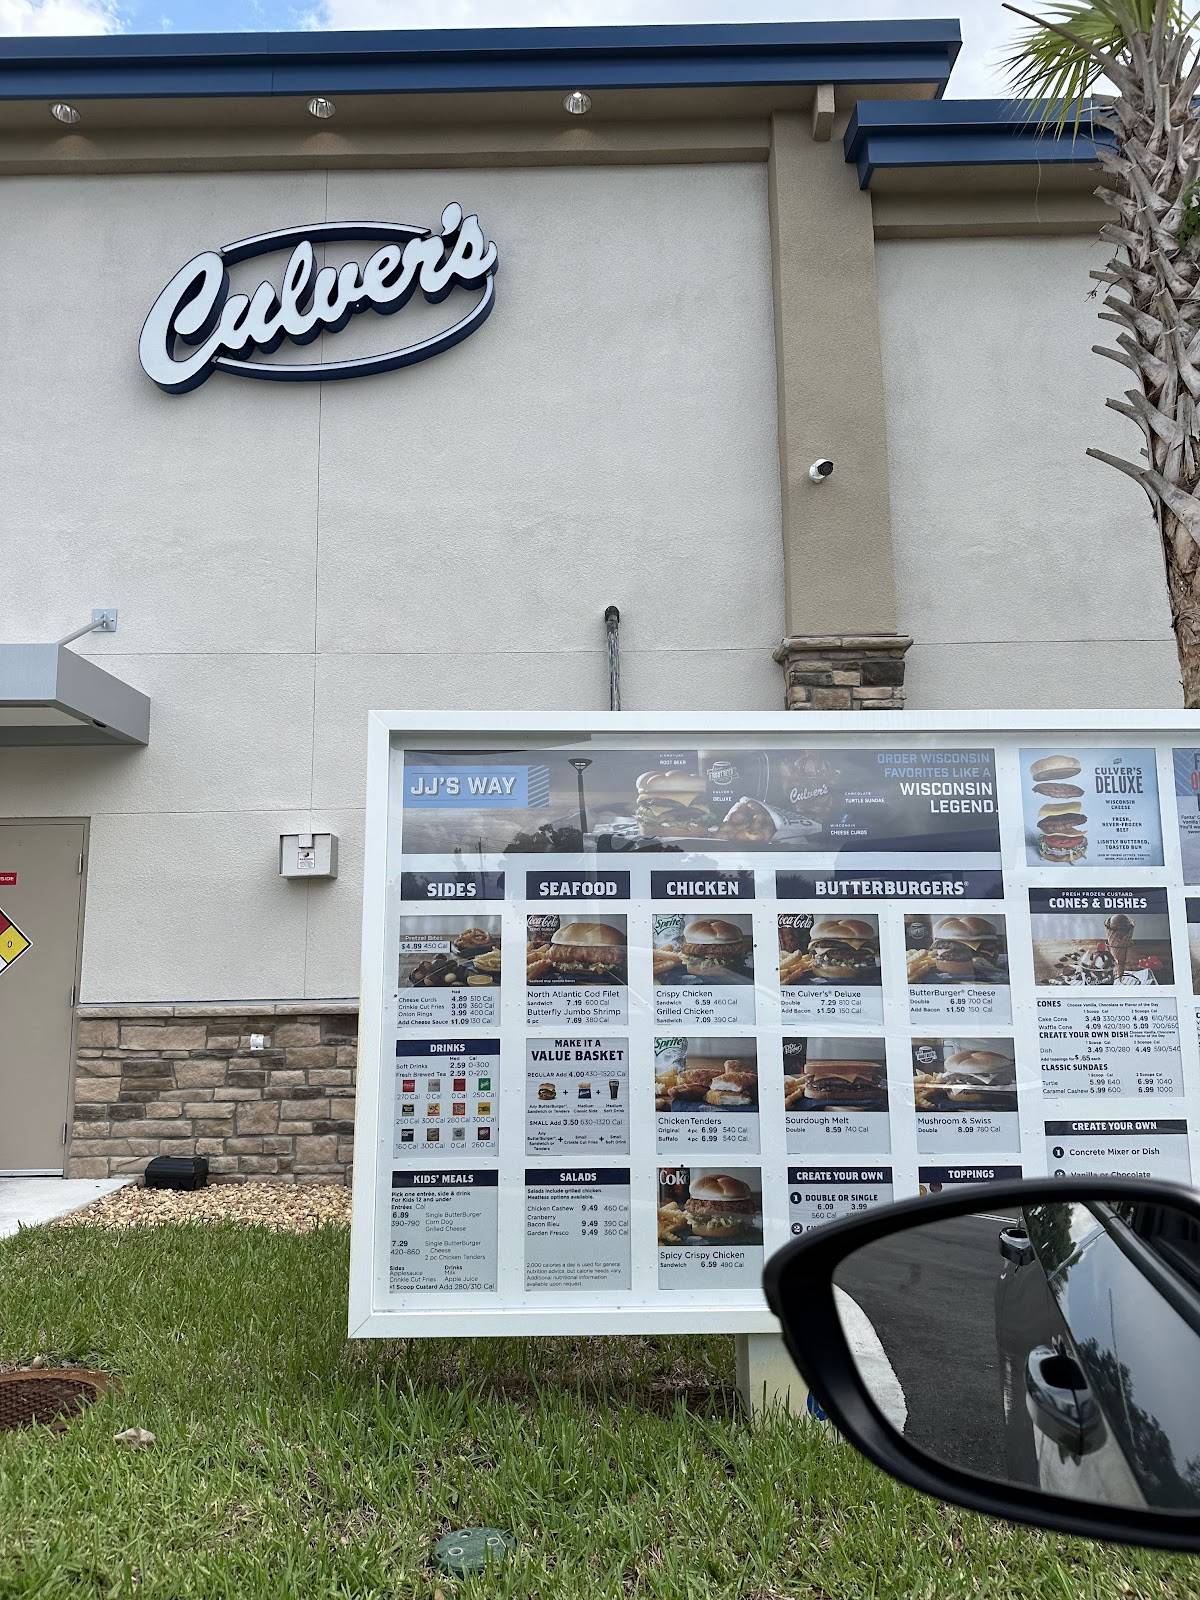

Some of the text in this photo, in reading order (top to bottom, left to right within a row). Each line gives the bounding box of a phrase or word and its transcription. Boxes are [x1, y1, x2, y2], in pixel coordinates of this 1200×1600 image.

[138, 202, 498, 394] Culver's
[877, 753, 990, 764] ORDER WISCONSIN
[884, 767, 991, 778] FAVORITES LIKE A
[1094, 767, 1142, 775] CULVER'S
[467, 777, 516, 795] WAY
[900, 782, 993, 796] WISCONSIN
[1095, 775, 1144, 794] DELUXE
[427, 882, 477, 897] SIDES
[539, 881, 617, 896] SEAFOOD
[666, 881, 739, 896] CHICKEN
[1049, 898, 1148, 909] CONES & DISHES
[655, 919, 680, 929] Sprite
[656, 990, 680, 998] Crispy
[527, 1008, 561, 1016] Butterfly
[593, 1008, 621, 1016] Shrimp
[1039, 1031, 1067, 1039] CREATE
[554, 1039, 601, 1047] MAKE IT A
[430, 1044, 466, 1053] DRINKS
[531, 1050, 624, 1061] VALUE BASKET
[690, 1117, 722, 1125] Tenders
[785, 1117, 830, 1125] Sourdough
[1072, 1121, 1158, 1131] CREATE YOUR OWN
[413, 1174, 474, 1184] KIDS' MEALS
[560, 1172, 597, 1182] SALADS
[796, 1172, 883, 1180] CREATE YOUR OWN
[948, 1170, 995, 1179] TOPPINGS
[660, 1251, 745, 1260] Spicy Crispy Chicken
